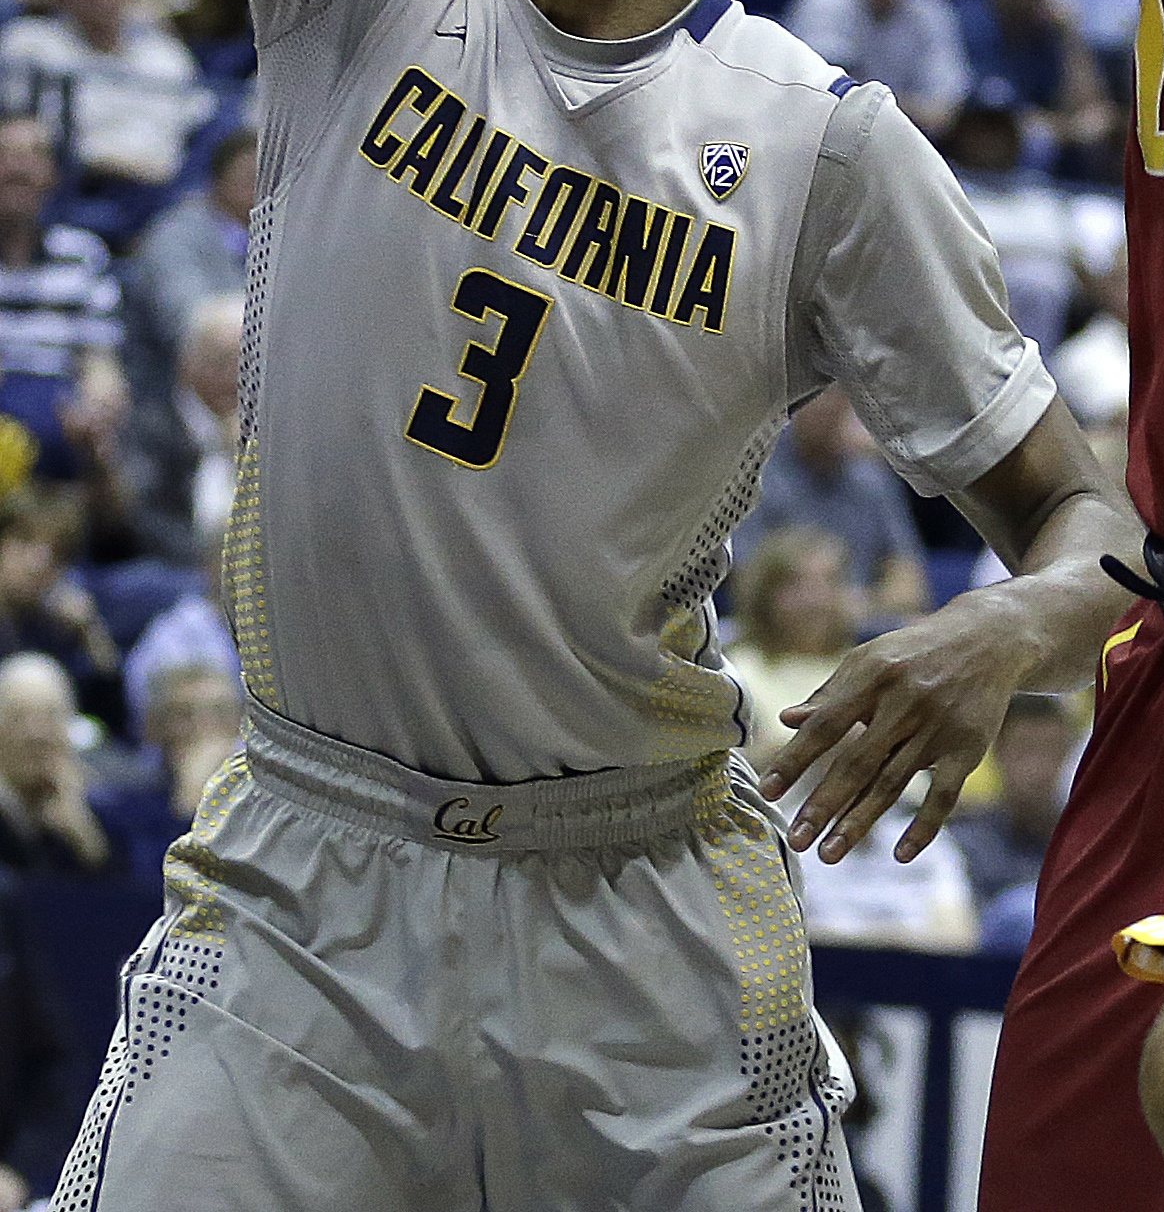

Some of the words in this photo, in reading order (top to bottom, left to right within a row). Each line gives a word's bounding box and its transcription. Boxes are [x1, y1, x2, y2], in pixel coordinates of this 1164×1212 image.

[703, 144, 747, 177] PAC
[710, 165, 734, 187] 12
[359, 65, 737, 334] CALIFORNIA
[404, 267, 555, 470] 3
[433, 796, 504, 843] Cal
